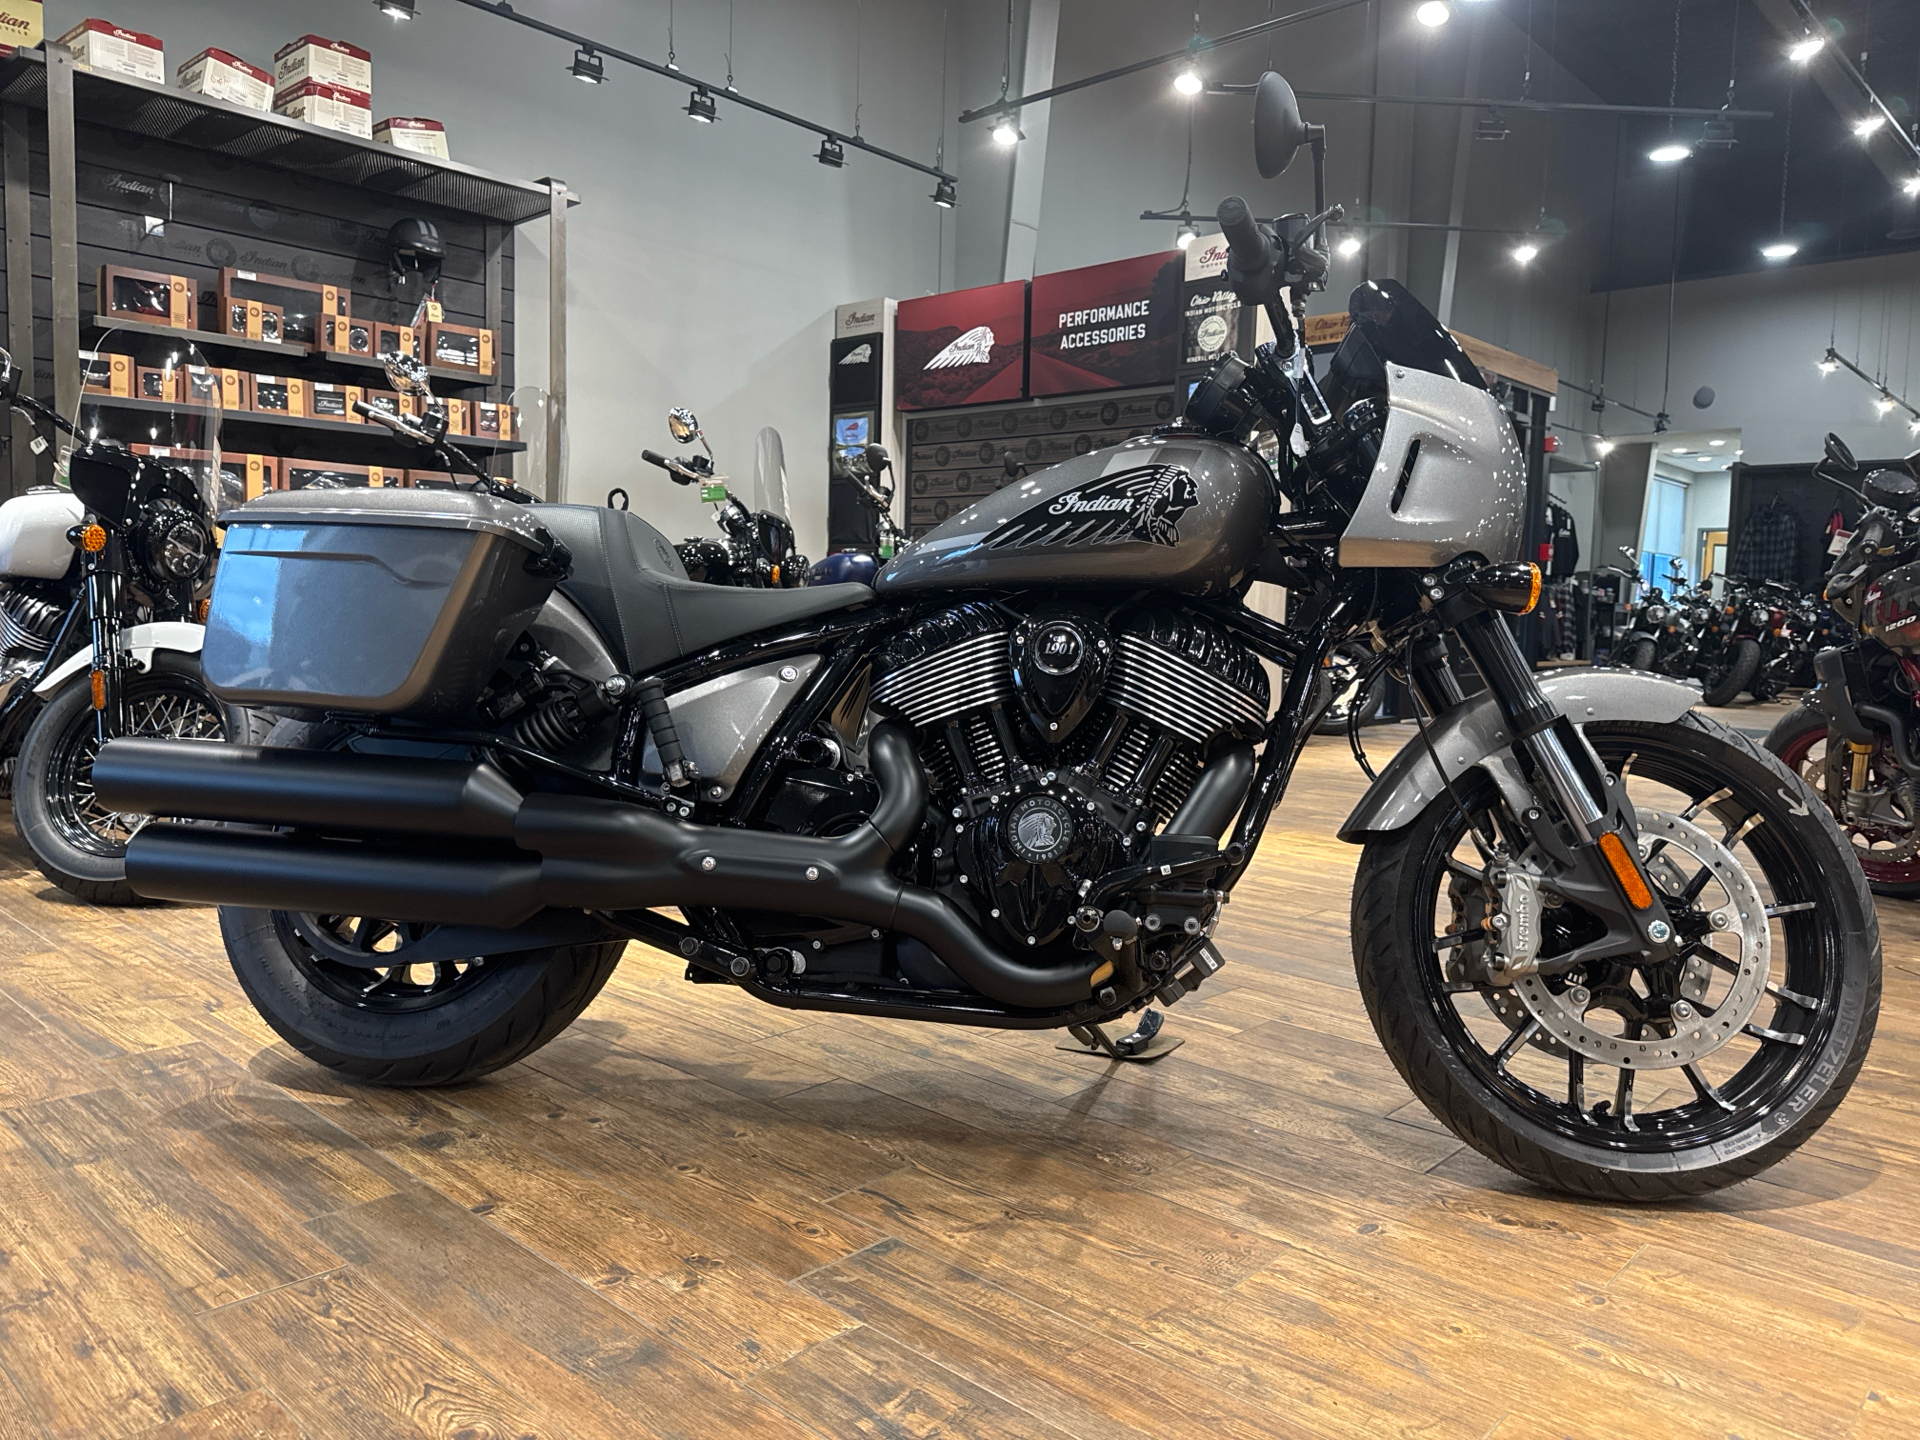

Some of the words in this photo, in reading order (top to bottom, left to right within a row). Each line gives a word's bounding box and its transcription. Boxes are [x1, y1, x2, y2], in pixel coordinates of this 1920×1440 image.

[278, 57, 305, 79] Indian
[102, 174, 155, 194] Indian
[1190, 293, 1211, 307] Ohio
[1204, 301, 1242, 315] MOTORCYCLE
[845, 311, 876, 326] Indian
[1058, 300, 1150, 329] PERFORMANCE
[1060, 323, 1146, 350] ACCESSORIES
[949, 341, 976, 353] Indian
[1049, 491, 1133, 515] Indian
[1885, 615, 1917, 632] 1200
[1044, 642, 1075, 655] 1901
[1010, 813, 1026, 854] INDIAN
[1020, 798, 1071, 843] MOTORCYCLE
[1036, 849, 1059, 861] 1901
[1514, 894, 1530, 952] brembo
[1787, 997, 1862, 1114] METZELER
